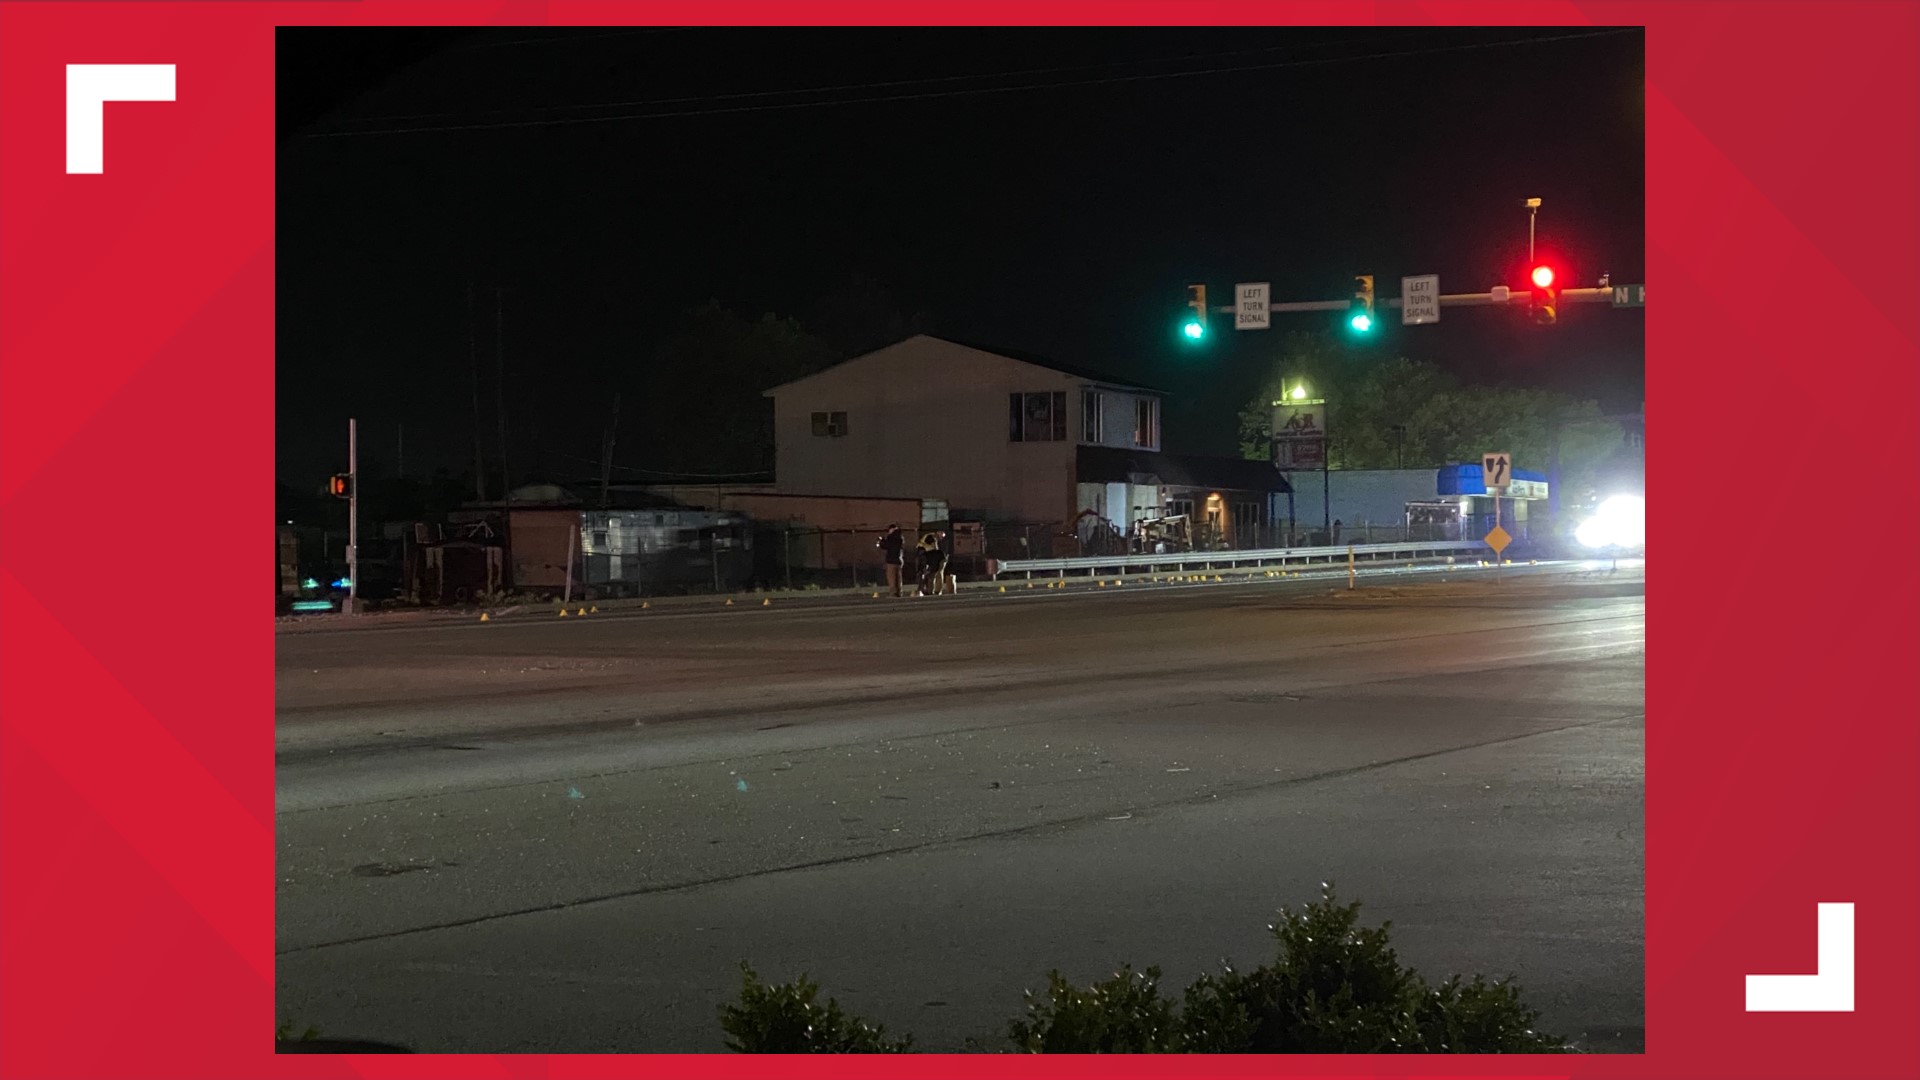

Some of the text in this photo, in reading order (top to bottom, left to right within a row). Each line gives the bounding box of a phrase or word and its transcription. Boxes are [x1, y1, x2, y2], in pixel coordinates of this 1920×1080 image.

[1411, 281, 1430, 292] LEFT
[1243, 289, 1262, 298] LEFT
[1615, 287, 1629, 303] N
[1410, 295, 1432, 305] TURN
[1243, 301, 1263, 311] TURN
[1406, 307, 1435, 317] SIGNAL
[1239, 313, 1266, 323] SIGNAL
